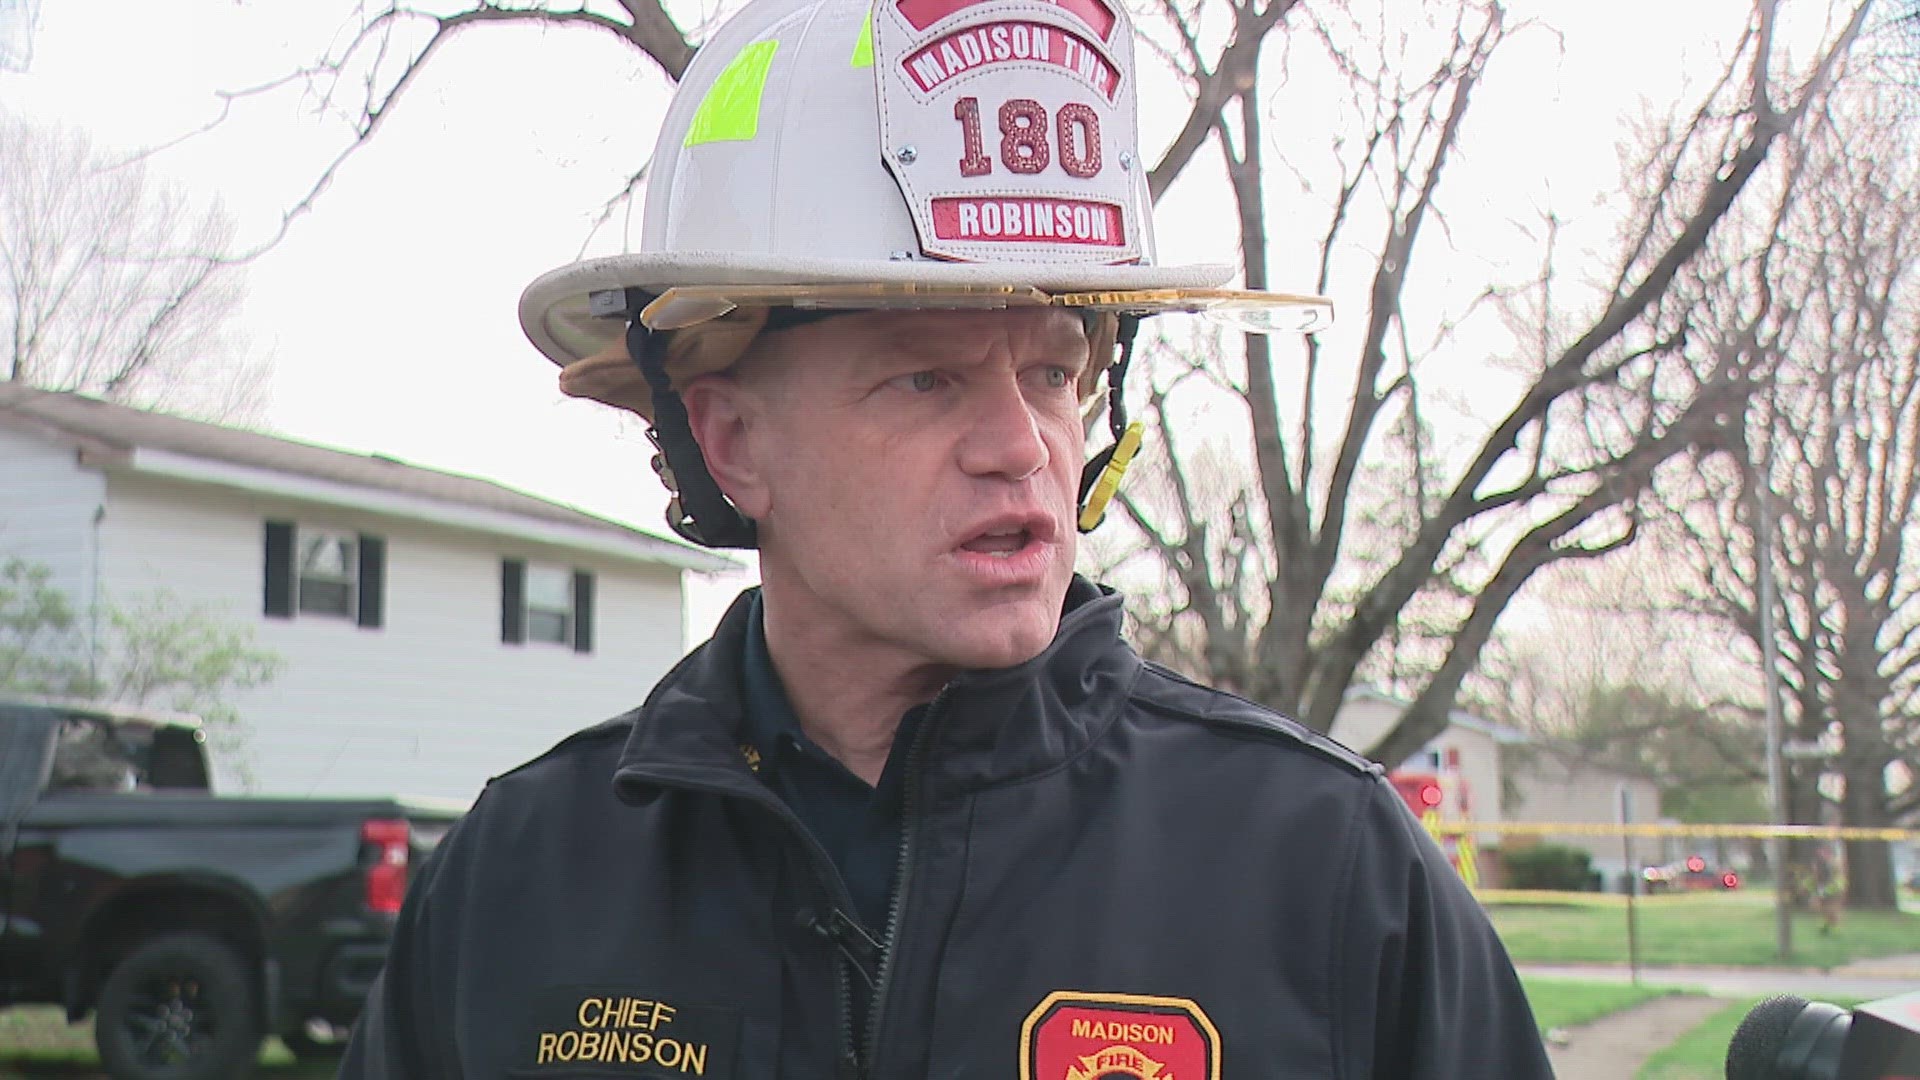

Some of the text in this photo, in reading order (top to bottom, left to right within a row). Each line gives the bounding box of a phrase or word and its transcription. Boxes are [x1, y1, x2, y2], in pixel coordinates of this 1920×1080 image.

[912, 27, 1049, 90] MADISON
[955, 97, 1102, 178] 180
[958, 202, 1108, 241] ROBINSON
[578, 998, 677, 1031] CHIEF
[1071, 1019, 1174, 1044] MADISON
[537, 1031, 708, 1076] ROBINSON
[1096, 1053, 1144, 1071] FIRE
